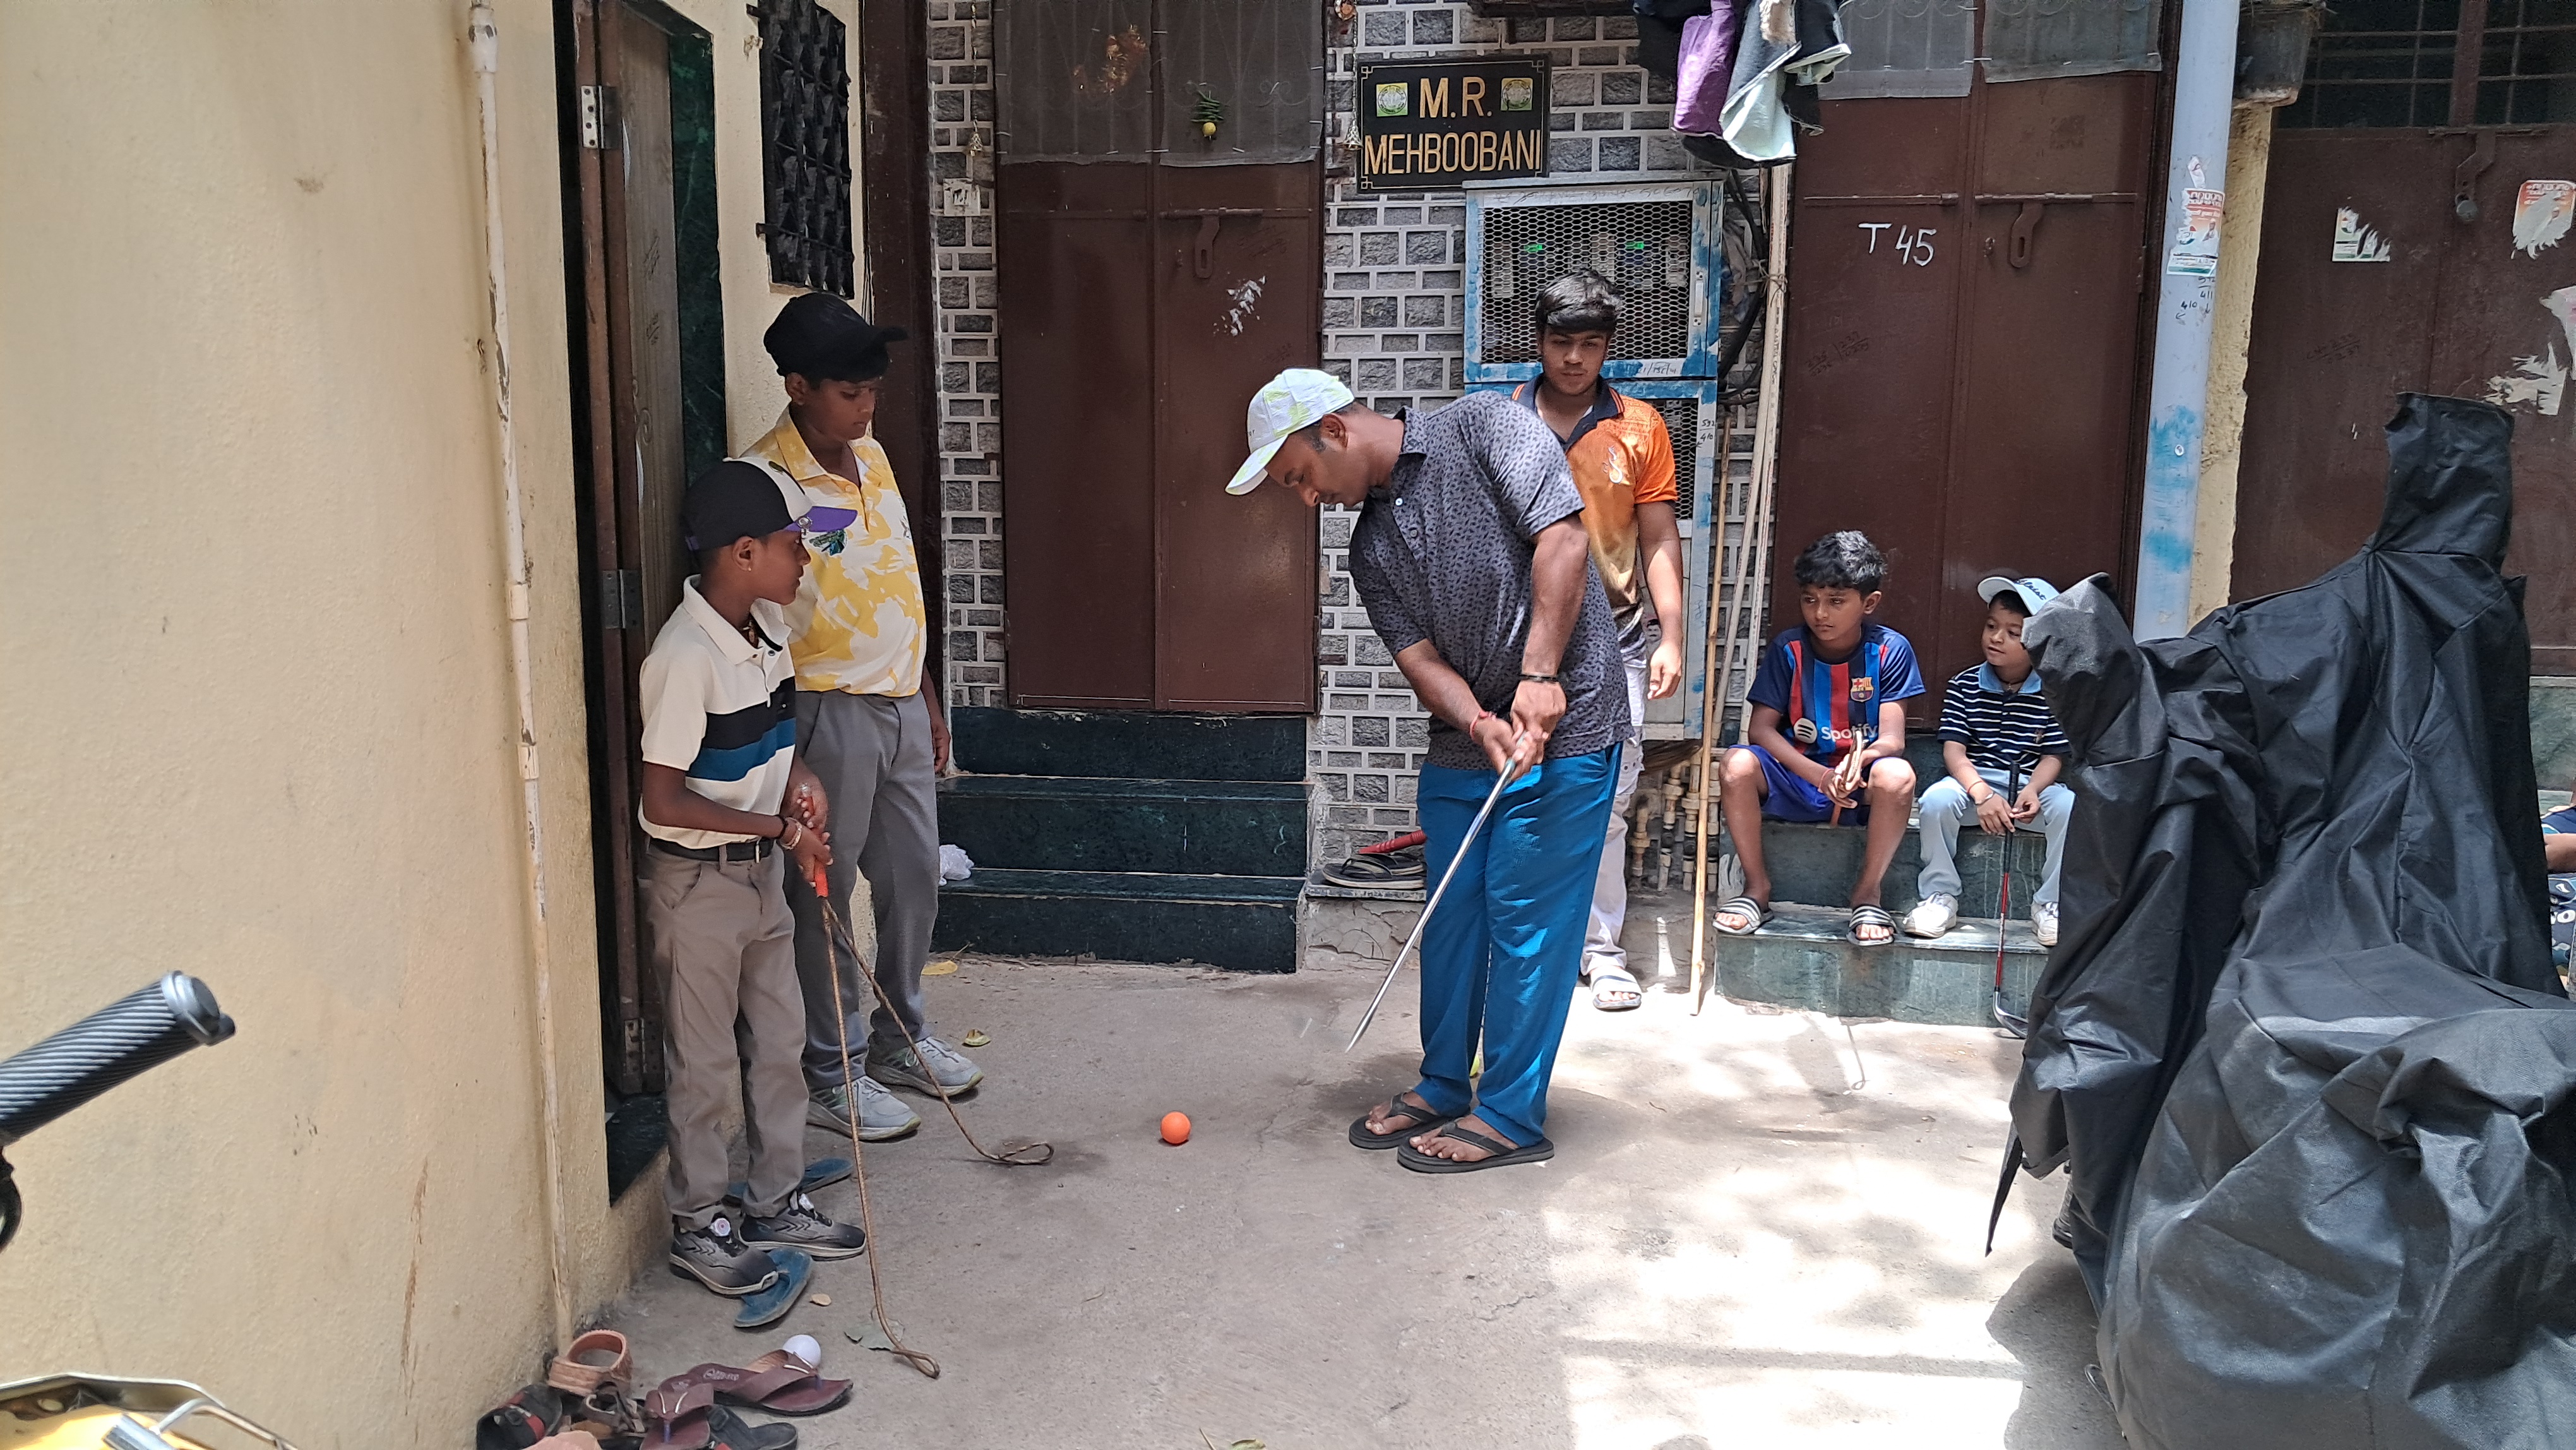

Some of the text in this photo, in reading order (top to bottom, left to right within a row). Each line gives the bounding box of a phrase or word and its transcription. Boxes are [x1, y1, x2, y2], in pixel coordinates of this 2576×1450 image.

[1419, 76, 1493, 119] M.R.
[1364, 129, 1541, 175] MEHBOOBANI
[1858, 223, 1937, 267] T 45
[2181, 300, 2198, 310] 410
[1700, 433, 1714, 442] 410
[1821, 723, 1878, 741] Spotify
